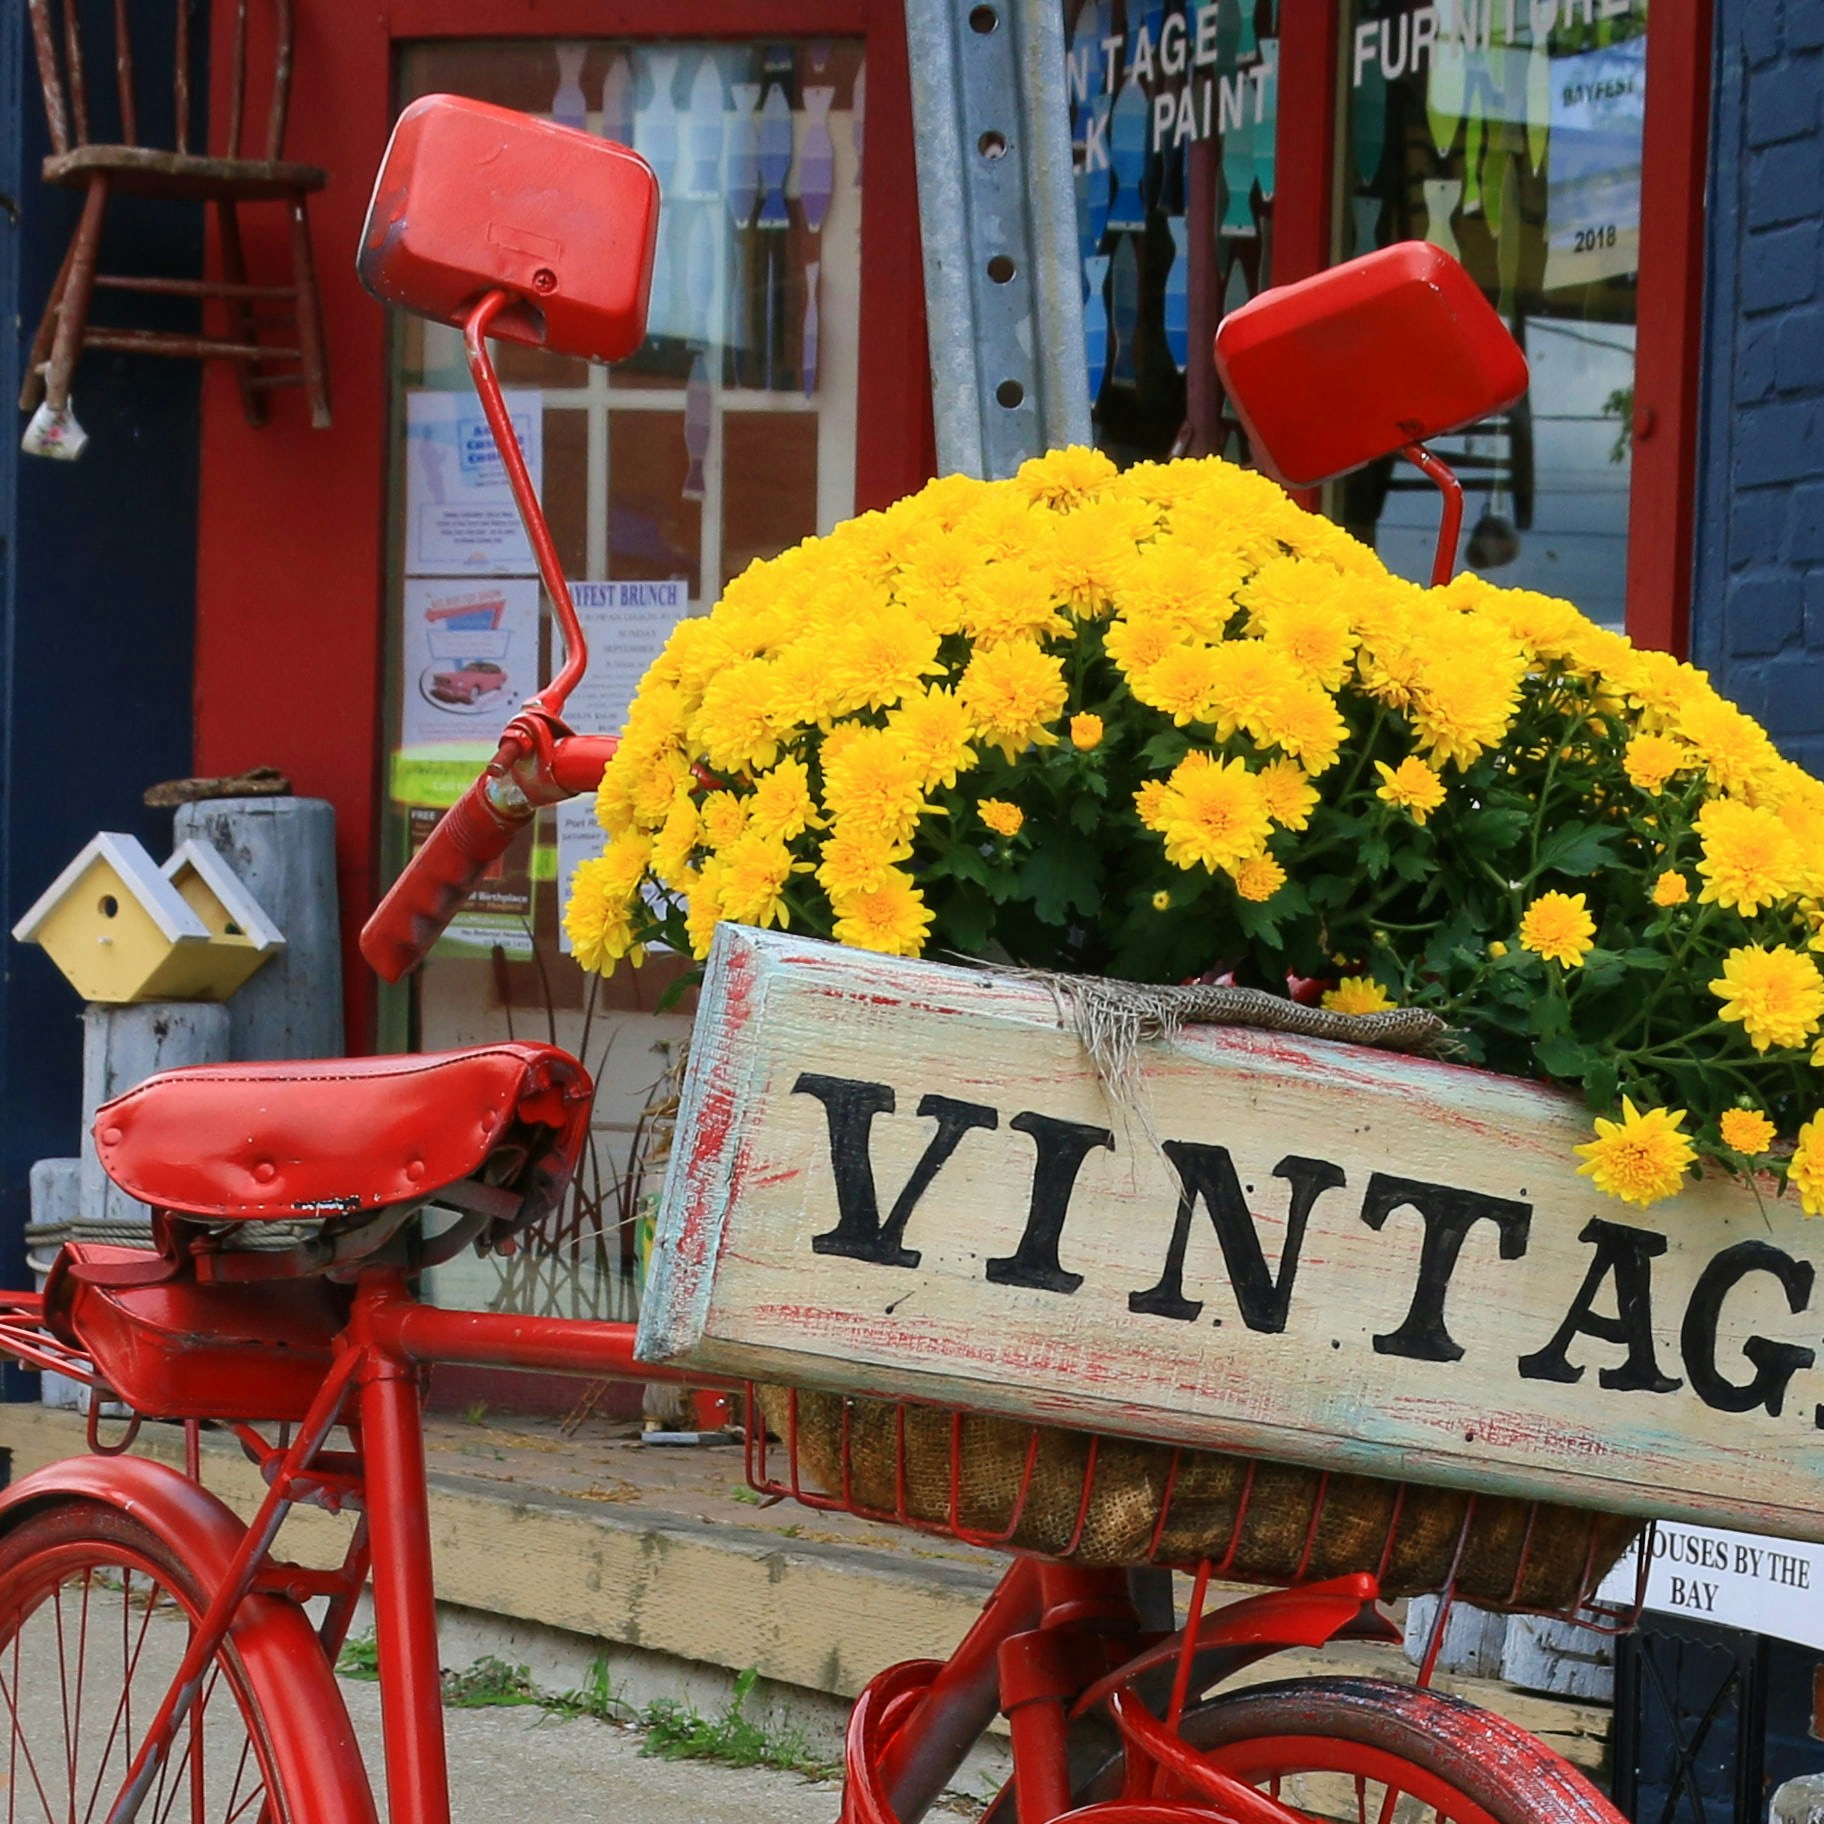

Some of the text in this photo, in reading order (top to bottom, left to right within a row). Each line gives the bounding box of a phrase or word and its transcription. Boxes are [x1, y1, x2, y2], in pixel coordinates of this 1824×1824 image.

[1354, 0, 1633, 87] FURNITU
[1153, 64, 1274, 153] PAINT
[1562, 80, 1635, 107] BAYFEST
[1573, 225, 1617, 253] 2018
[620, 584, 677, 607] BRUNCH
[1733, 1544, 1764, 1578] BY
[1767, 1552, 1811, 1590] THE
[1669, 1575, 1720, 1612] BAY
